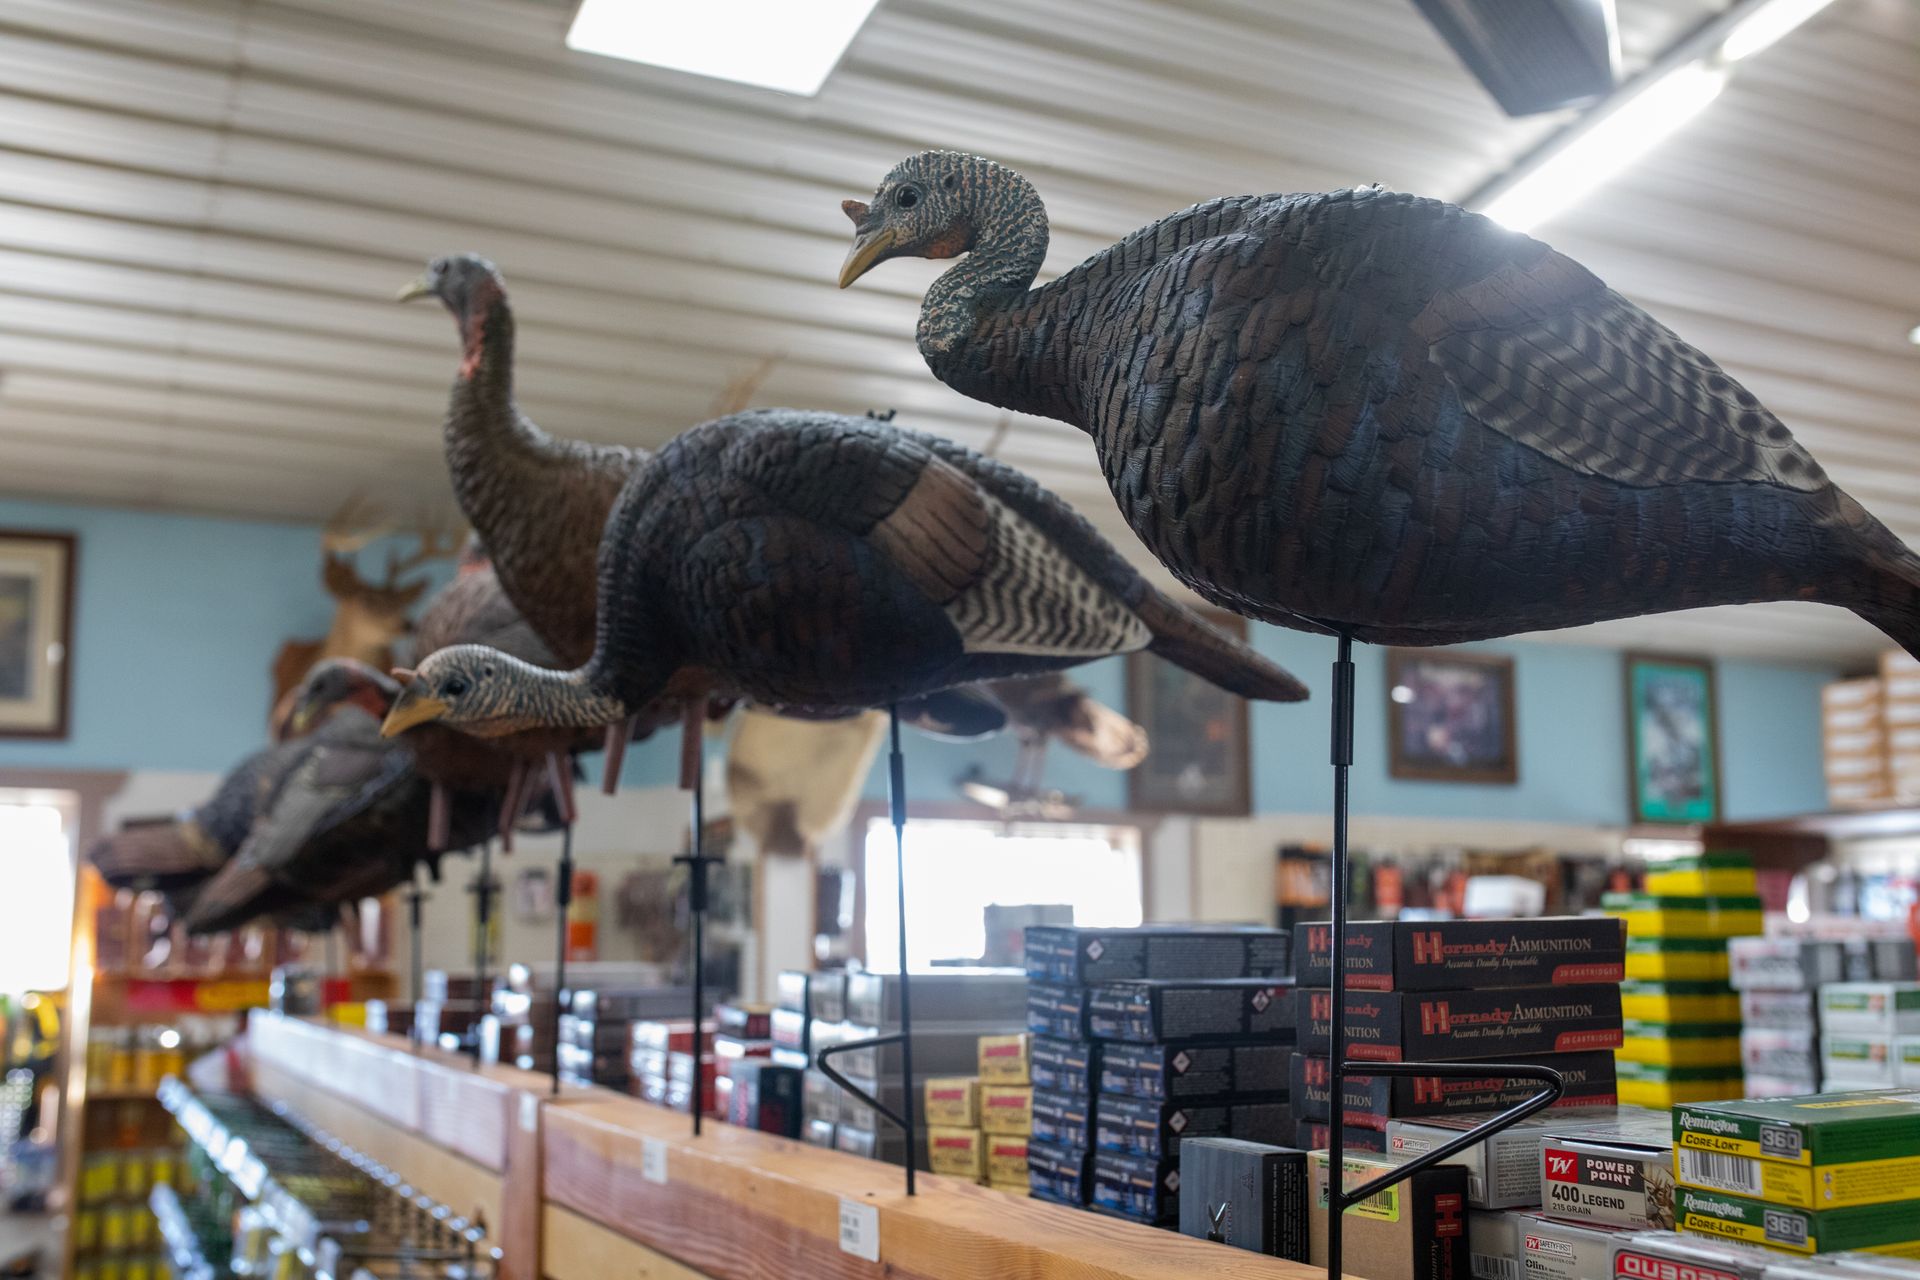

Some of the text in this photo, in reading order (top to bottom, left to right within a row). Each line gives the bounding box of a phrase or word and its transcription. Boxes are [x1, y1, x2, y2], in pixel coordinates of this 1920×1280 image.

[1412, 931, 1508, 965] Hornady
[1420, 1001, 1513, 1035] Hornady
[1680, 1111, 1740, 1134] Remington
[1763, 1130, 1797, 1149] 360
[1586, 1159, 1635, 1174] POWER
[1590, 1171, 1632, 1186] POINT
[1552, 1184, 1625, 1210] 400 LEGEND
[1683, 1193, 1744, 1217] Remington
[1552, 1203, 1592, 1216] 215 GRAIN
[1767, 1215, 1803, 1236] 360
[1525, 1259, 1544, 1271] Olin
